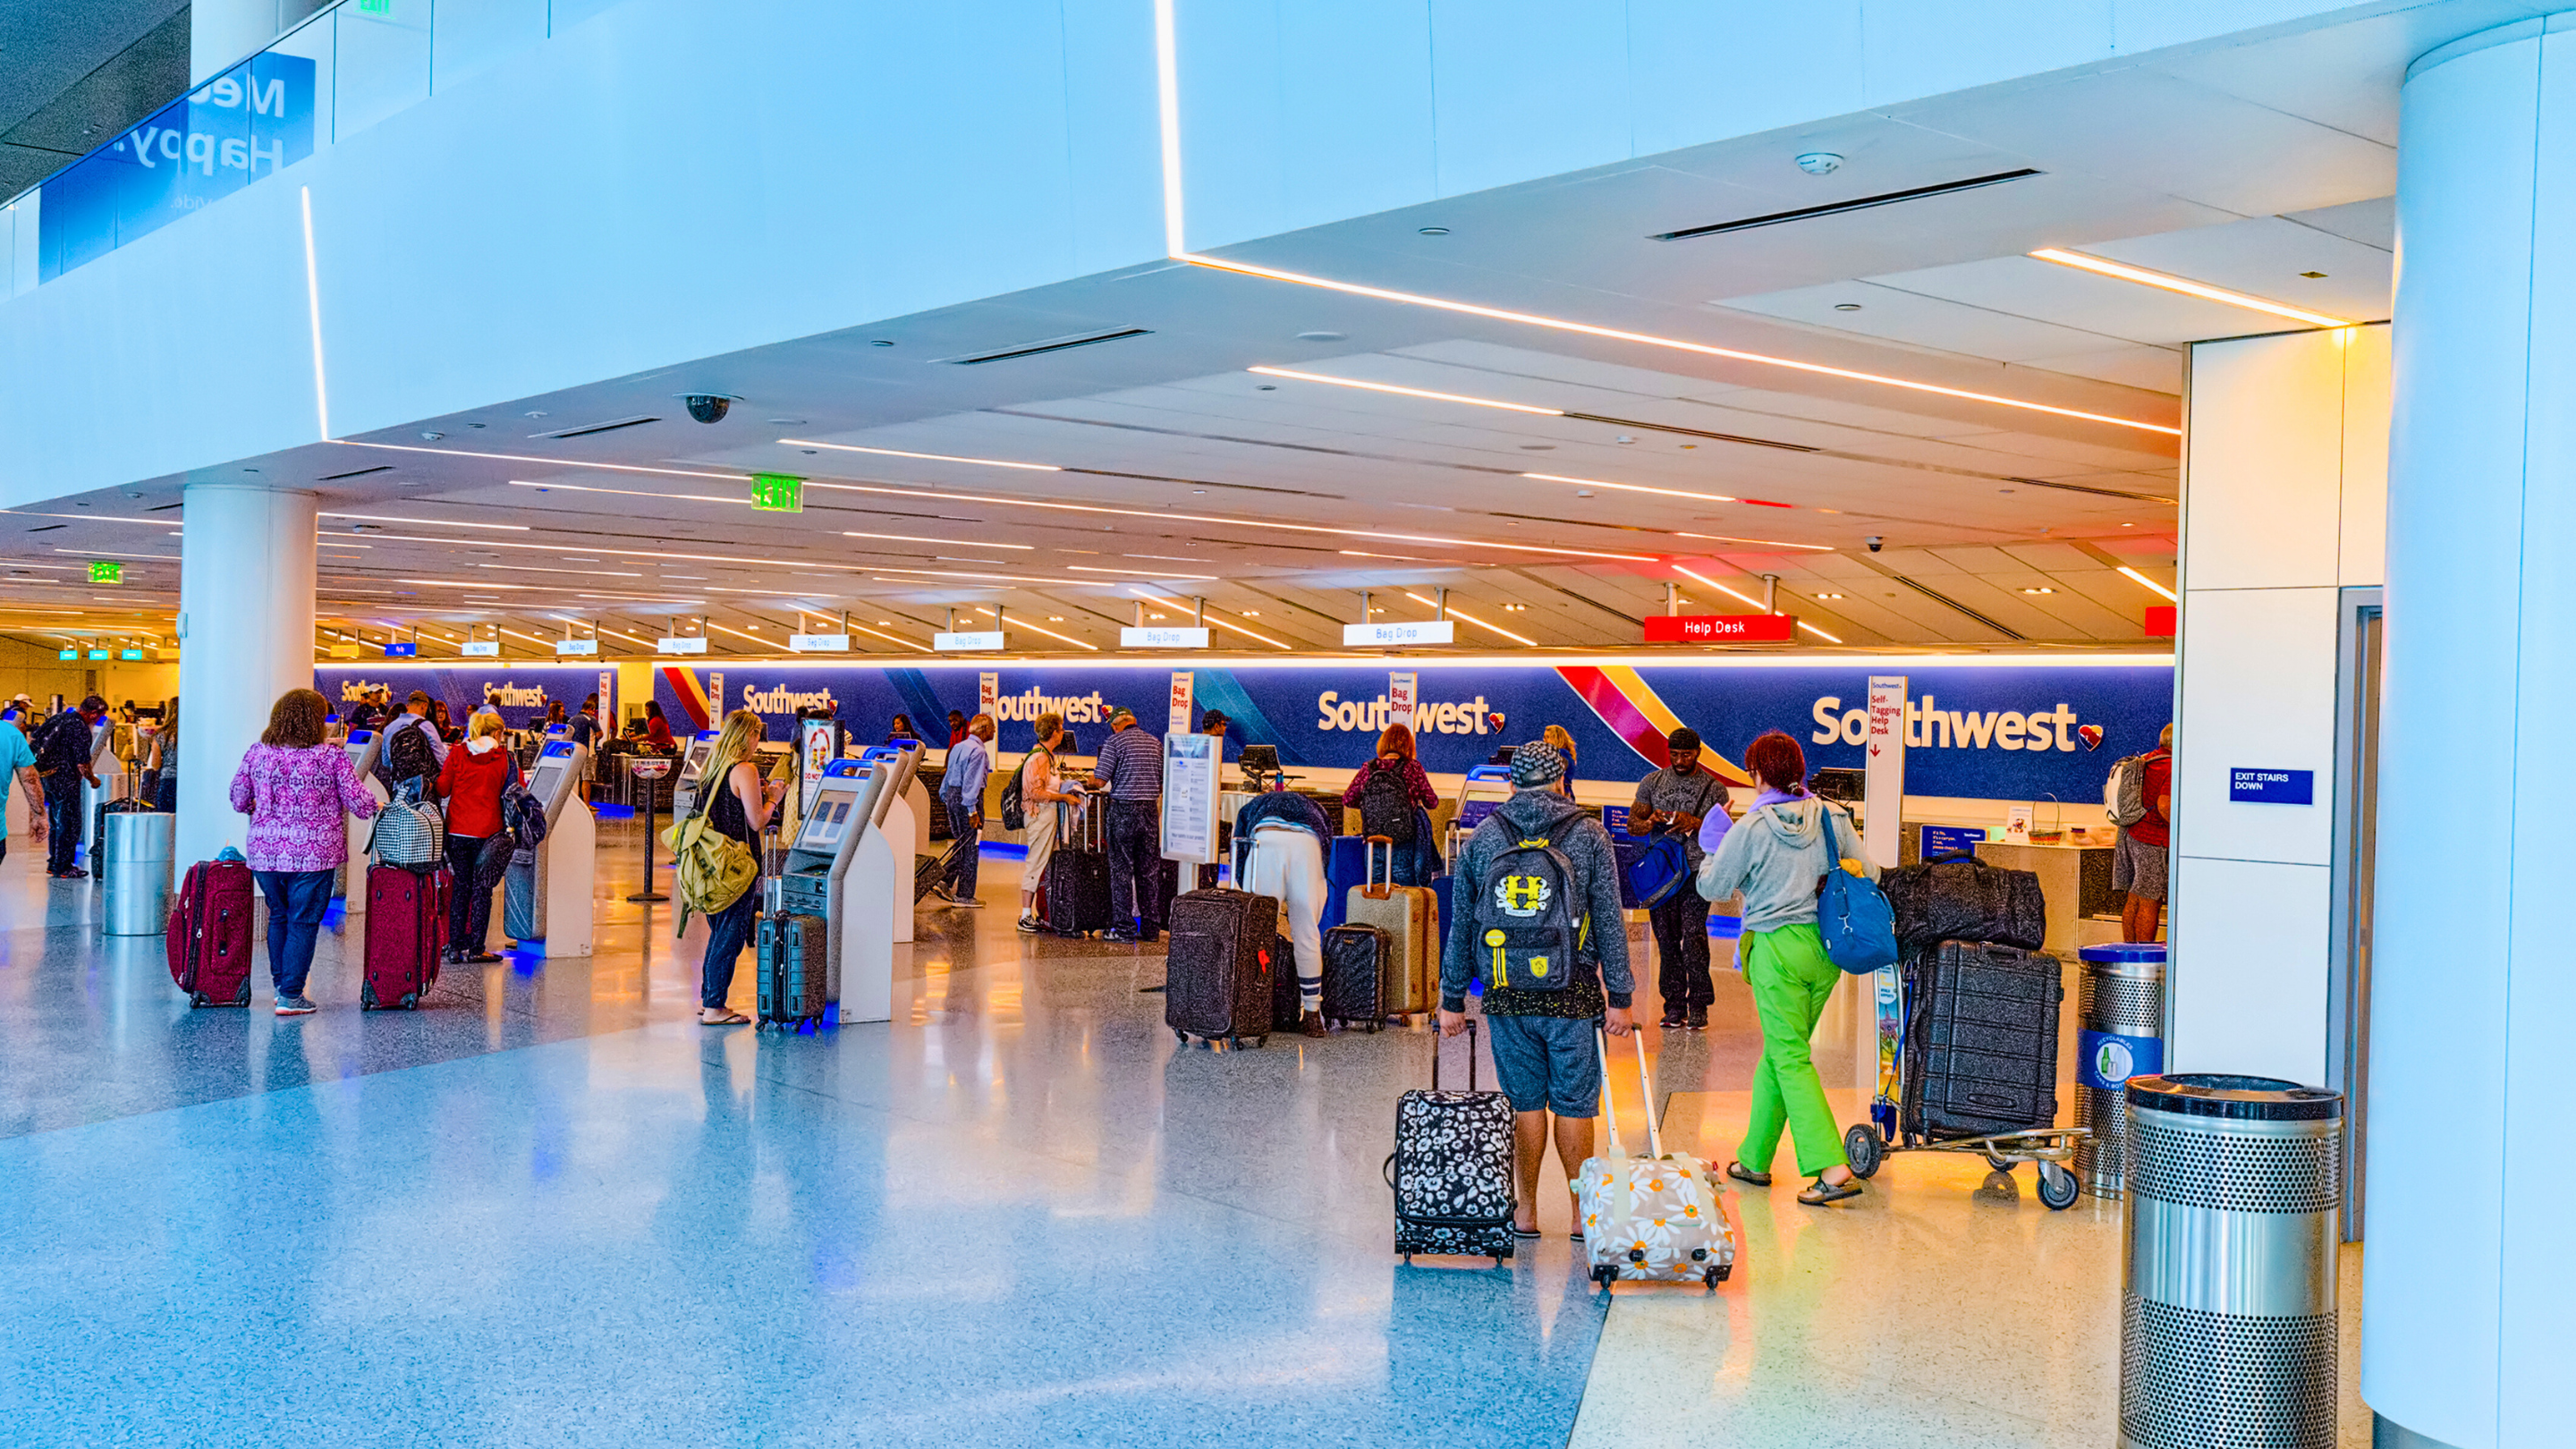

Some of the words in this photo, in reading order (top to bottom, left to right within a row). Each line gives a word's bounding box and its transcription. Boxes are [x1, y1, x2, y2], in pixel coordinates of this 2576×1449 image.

[759, 477, 799, 509] EXIT
[1376, 628, 1393, 641] Bag
[1396, 627, 1418, 640] Drop
[1684, 622, 1711, 636] Help
[1716, 621, 1745, 633] Desk
[808, 638, 818, 648] Bag
[818, 638, 830, 647] Drop
[954, 636, 966, 647] Bag
[967, 636, 981, 646] Drop
[1147, 631, 1161, 644] Bag
[1163, 631, 1181, 643] Drop
[981, 684, 992, 695] Bag
[1173, 685, 1186, 698] Bag
[1392, 687, 1408, 701] Bag
[981, 696, 994, 707] Drop
[997, 686, 1103, 723] outhwest
[1173, 698, 1188, 709] Drop
[1871, 695, 1888, 703] Self-
[1318, 691, 1489, 735] Soutwest
[1392, 701, 1412, 715] Drop
[1871, 706, 1901, 716] Tagging
[1811, 695, 2077, 752] Sothwest
[1871, 716, 1889, 726] Help
[1870, 726, 1889, 735] Desk
[2235, 772, 2256, 781] EXIT
[2257, 773, 2289, 782] STAIRS
[2234, 782, 2263, 790] DOWN
[2097, 1035, 2134, 1051] RECYCLABLES
